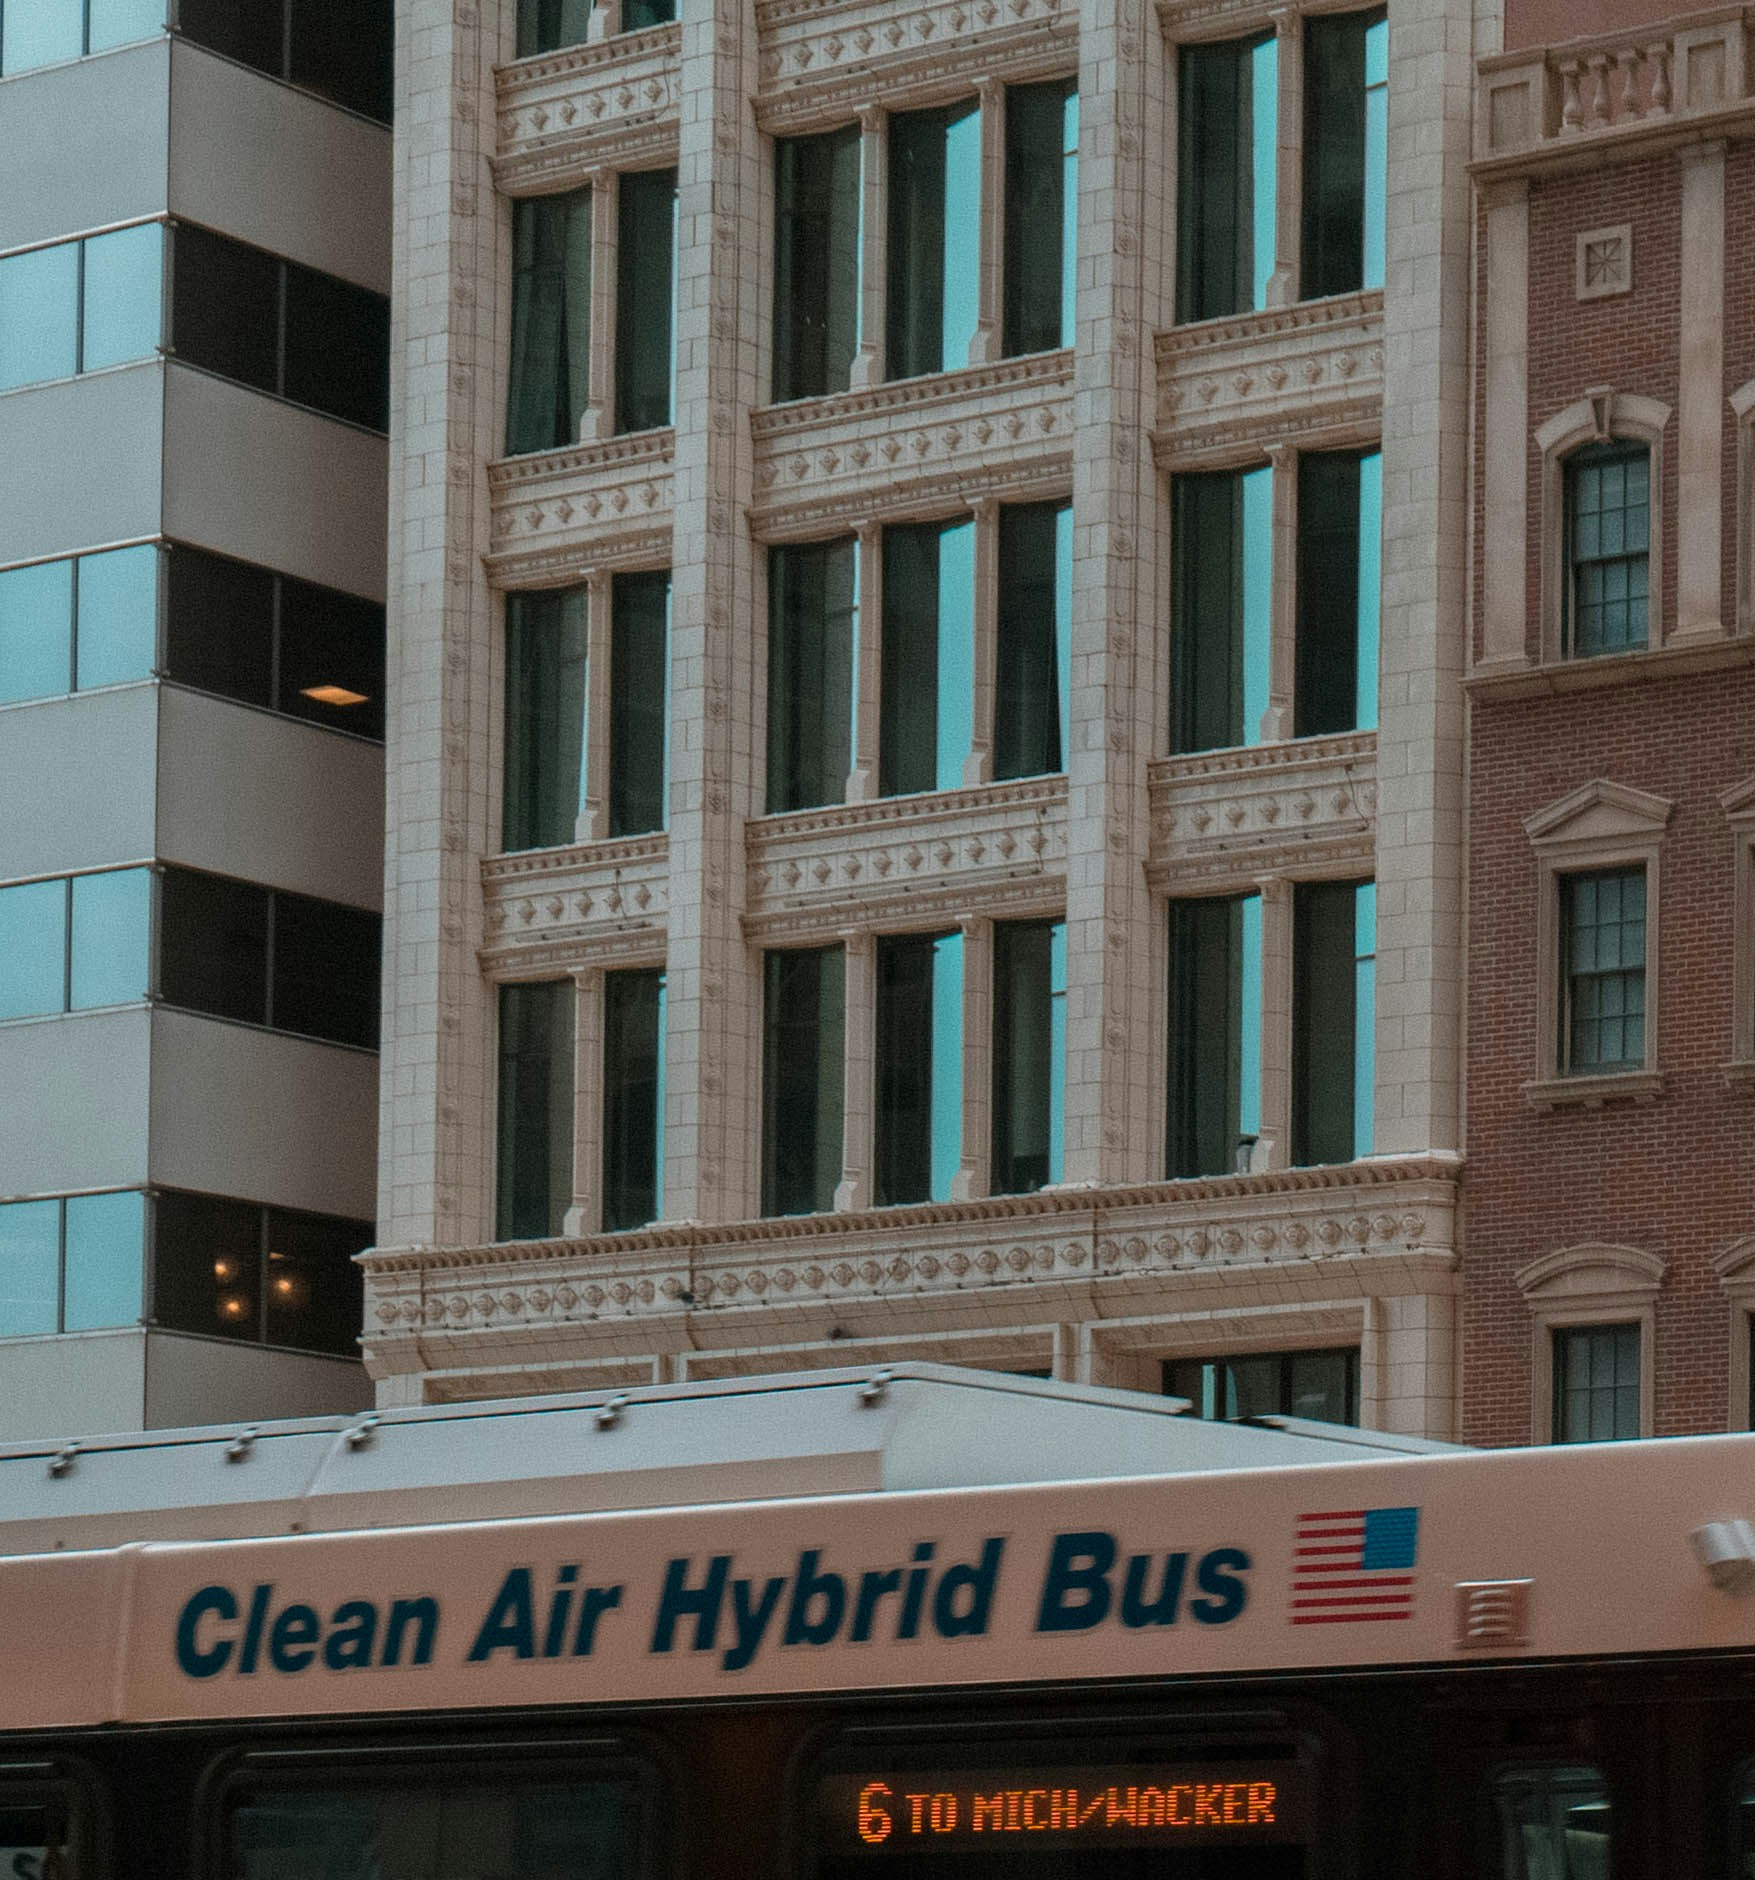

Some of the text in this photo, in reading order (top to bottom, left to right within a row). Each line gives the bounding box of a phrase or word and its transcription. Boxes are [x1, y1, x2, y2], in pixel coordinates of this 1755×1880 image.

[174, 1529, 1254, 1681] Clean Air Hybrid Bus
[857, 1781, 1278, 1844] 6 TO MICH/WACKER
